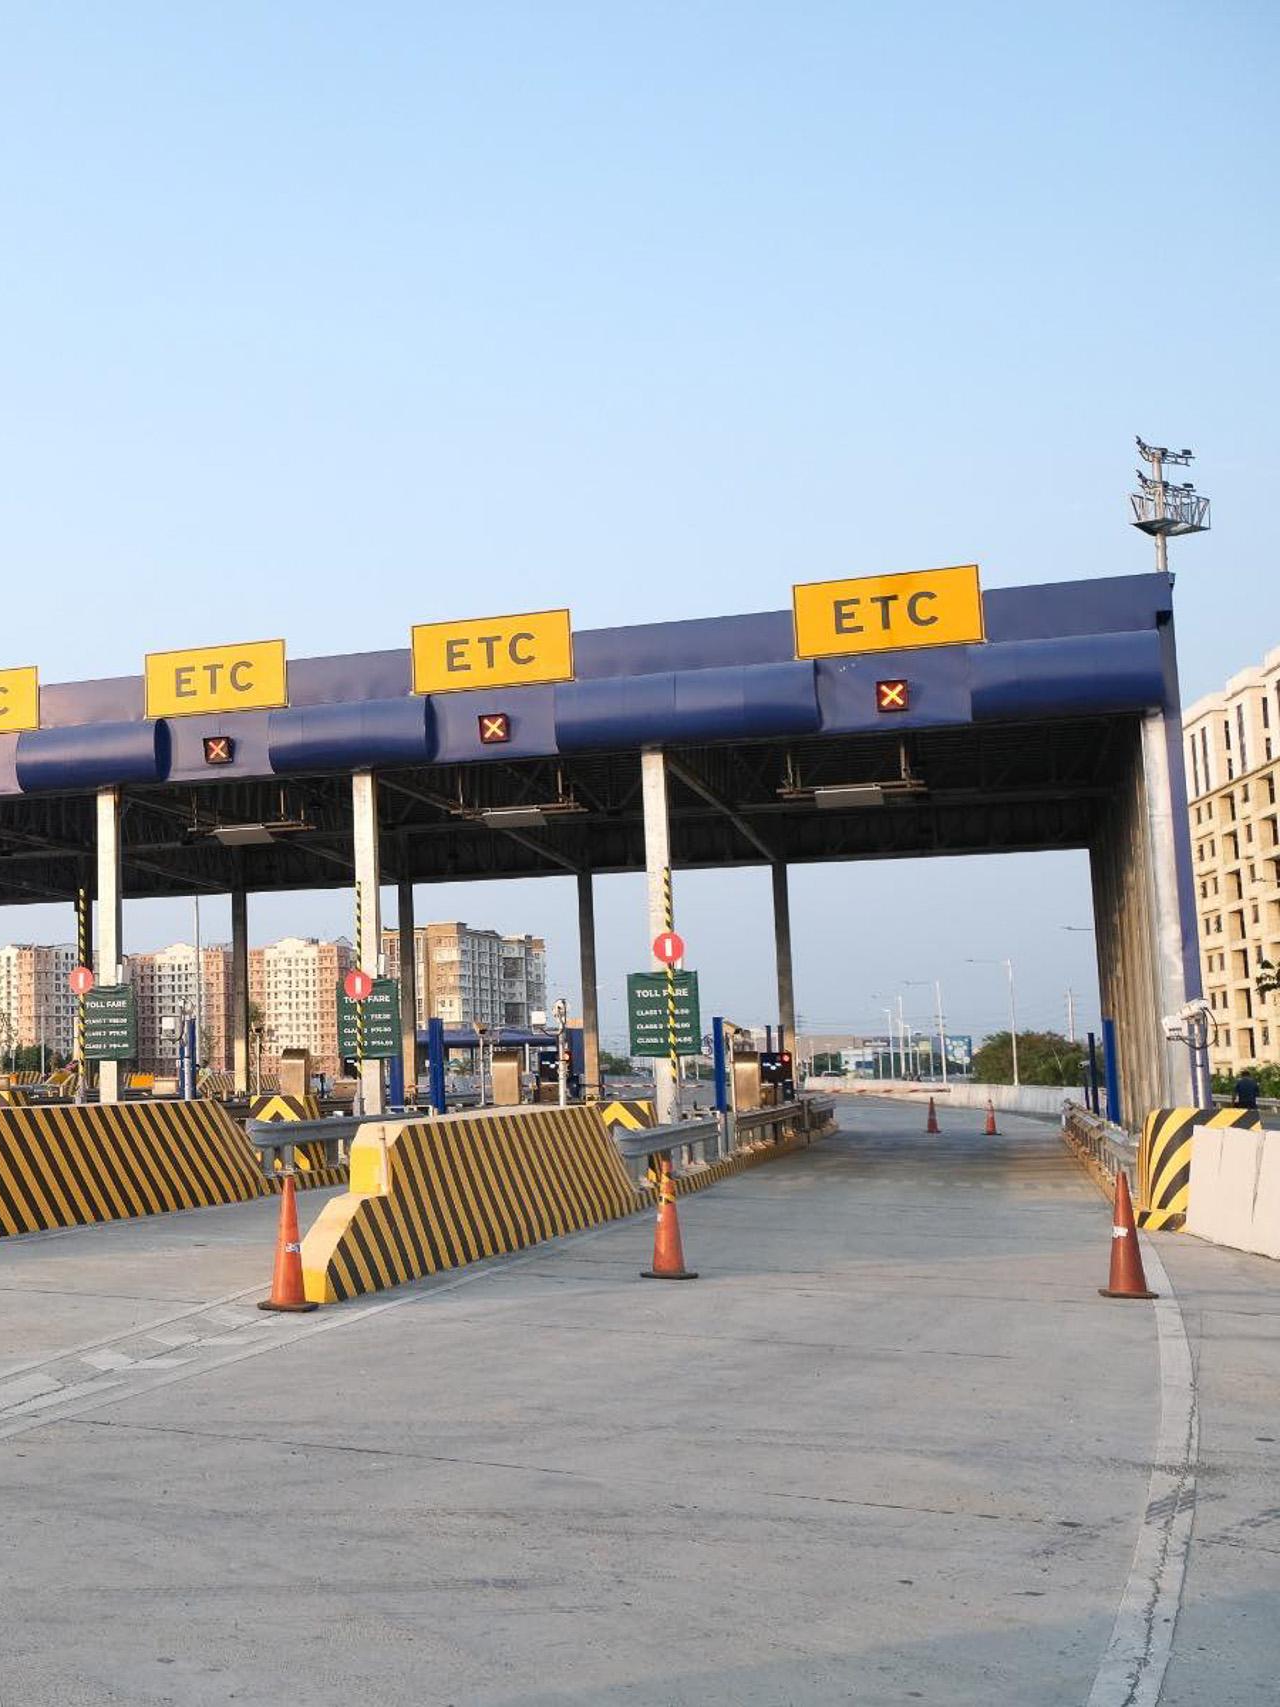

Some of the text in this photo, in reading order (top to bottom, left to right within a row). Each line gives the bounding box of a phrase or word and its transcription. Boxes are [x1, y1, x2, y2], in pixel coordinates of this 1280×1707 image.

[833, 591, 938, 634] ETC
[446, 632, 536, 672] ETC
[175, 660, 254, 698] ETC
[106, 1000, 128, 1008] FARE
[367, 995, 391, 1003] FARE
[635, 989, 661, 998] TOLL
